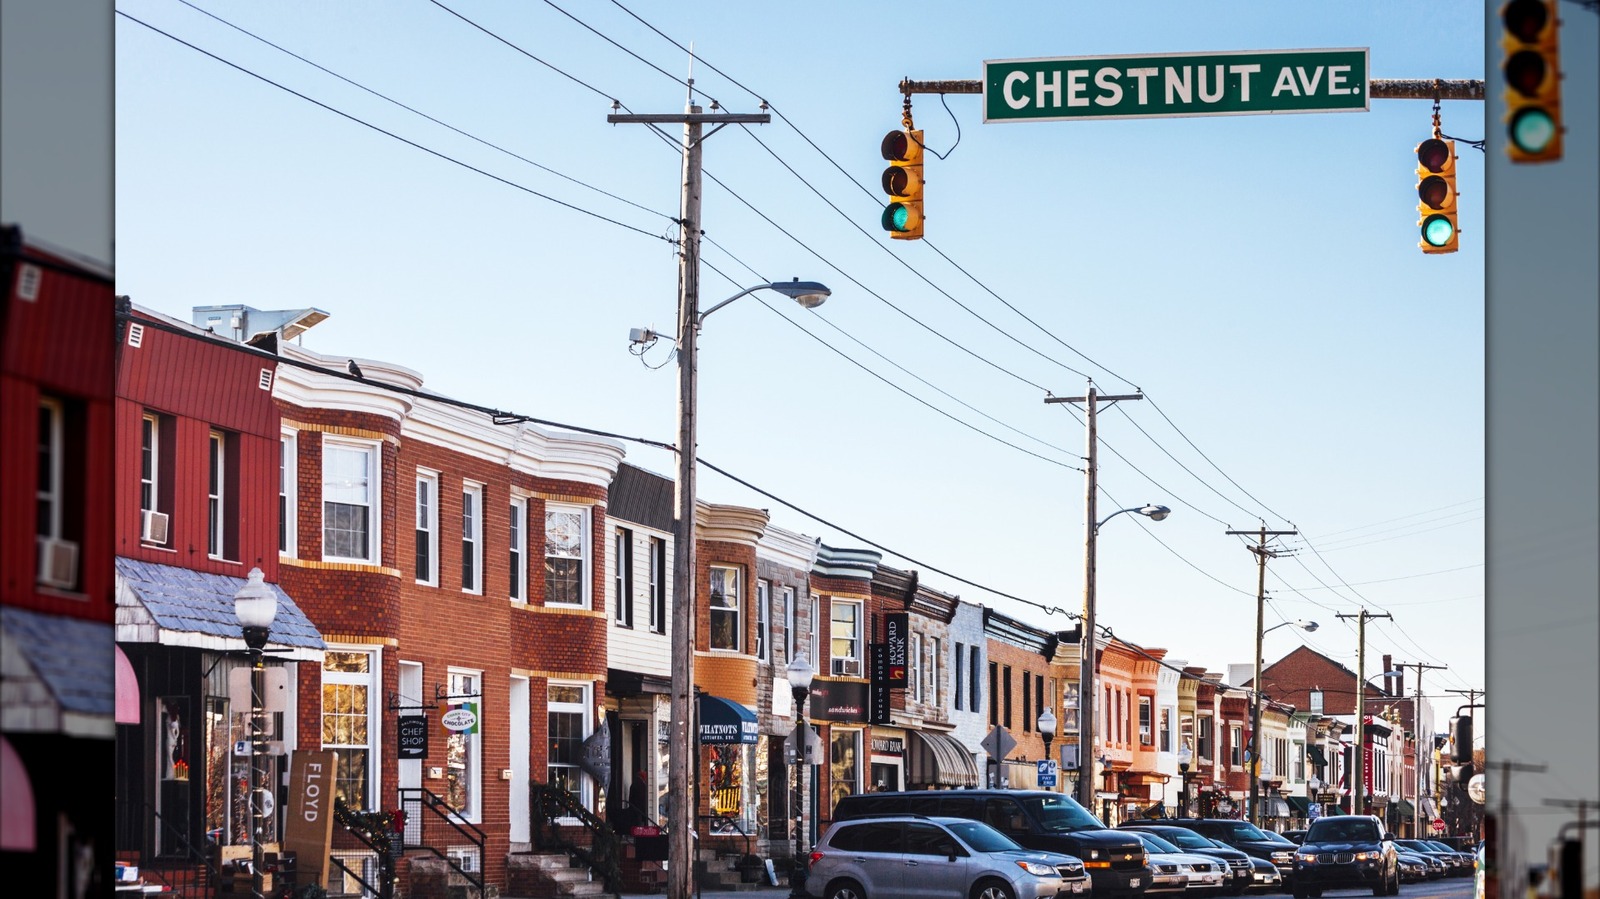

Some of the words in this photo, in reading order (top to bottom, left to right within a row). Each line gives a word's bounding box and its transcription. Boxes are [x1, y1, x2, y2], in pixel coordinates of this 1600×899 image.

[1003, 64, 1261, 110] CHESTNUT
[1271, 65, 1360, 98] AVE.
[889, 621, 897, 665] HOWARD
[897, 637, 905, 666] BANK
[828, 705, 858, 714] sandwiches
[401, 727, 424, 736] CHEF
[443, 718, 474, 727] CHOCOLATE
[401, 737, 424, 746] SHOP
[304, 763, 322, 822] FLOYD
